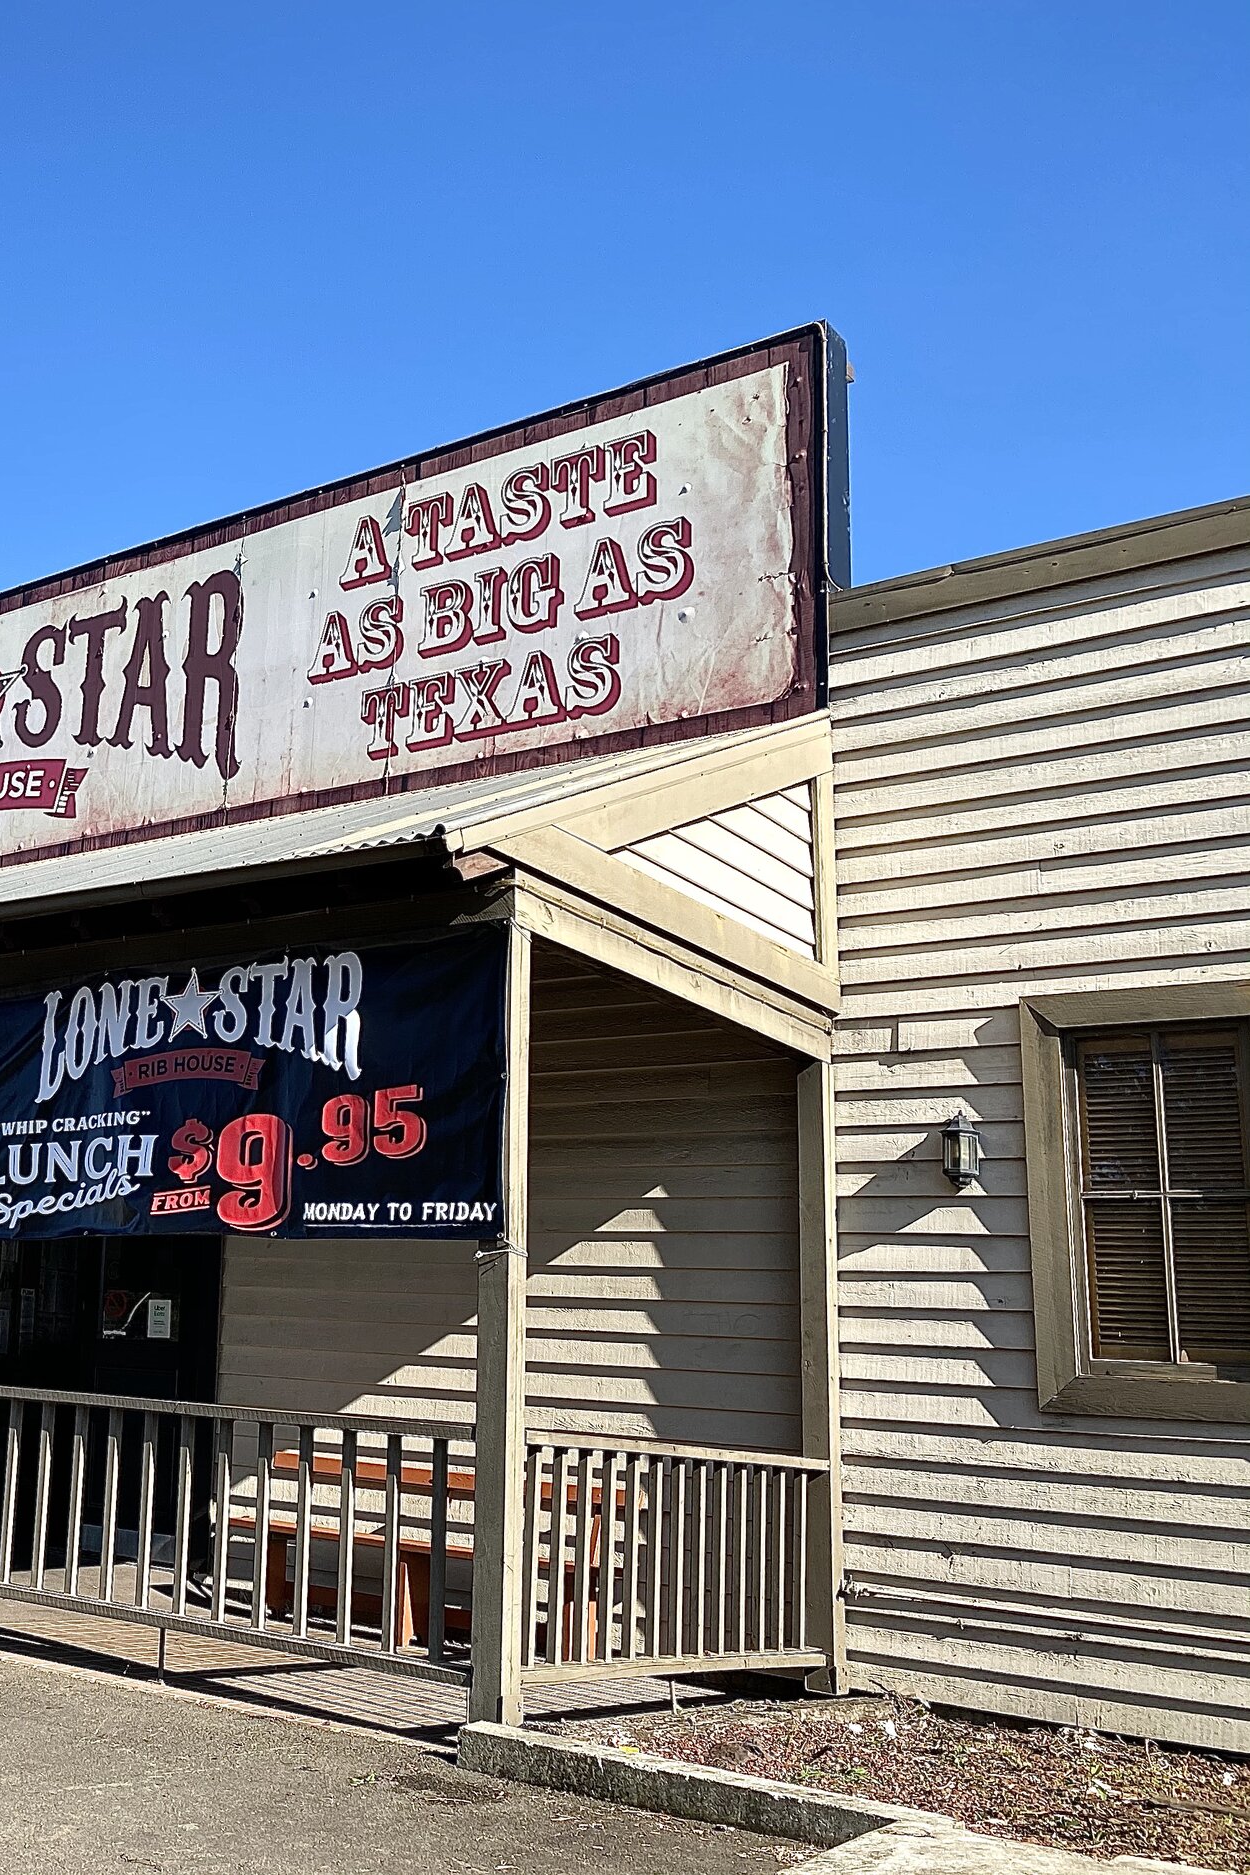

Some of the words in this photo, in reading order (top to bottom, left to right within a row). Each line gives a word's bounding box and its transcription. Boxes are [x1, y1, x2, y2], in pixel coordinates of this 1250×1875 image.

[340, 514, 392, 591] A
[405, 429, 657, 571] TASTE
[308, 595, 404, 685] AS
[418, 552, 565, 660] BIG
[574, 515, 695, 621] AS
[13, 569, 245, 781] STAR
[362, 632, 622, 761] TEXAS
[35, 974, 168, 1103] LONE
[213, 951, 363, 1080] STAR
[138, 1059, 168, 1080] RIB
[174, 1054, 237, 1073] HOUSE
[151, 1190, 211, 1211] FROM
[303, 1202, 380, 1221] MONDAY
[388, 1202, 412, 1221] TO
[422, 1202, 498, 1221] FRIDAY
